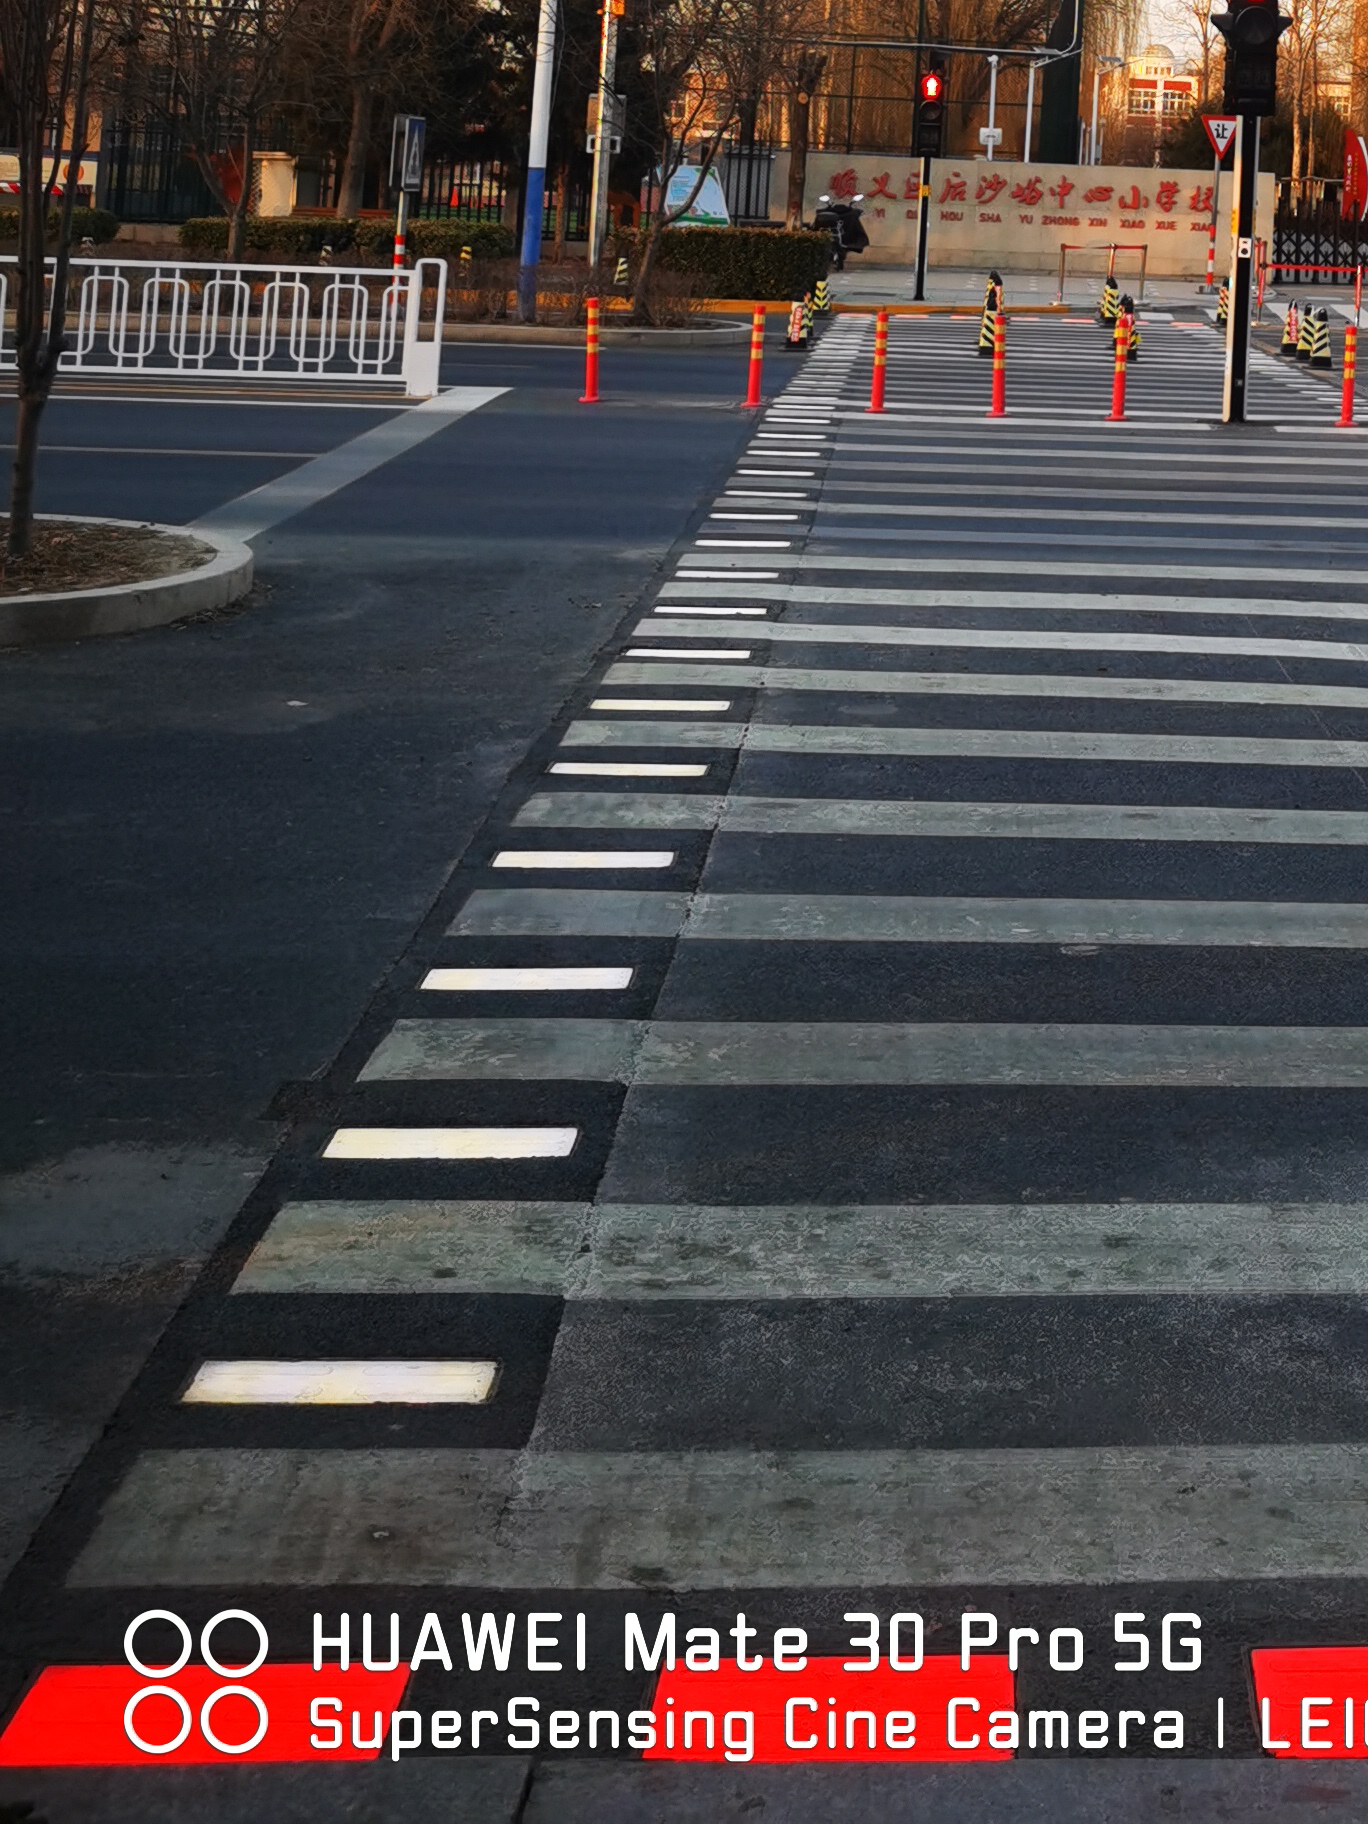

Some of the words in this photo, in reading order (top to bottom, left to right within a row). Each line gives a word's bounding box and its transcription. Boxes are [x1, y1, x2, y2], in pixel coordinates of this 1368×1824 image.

[1214, 123, 1229, 139] 让
[940, 210, 964, 222] HOU
[979, 212, 1002, 223] SHA
[1019, 214, 1033, 224] YU
[1041, 215, 1080, 227] ZHONG
[1088, 217, 1108, 227] XIN
[1120, 218, 1146, 229] XIAO
[1155, 220, 1177, 231] XUE
